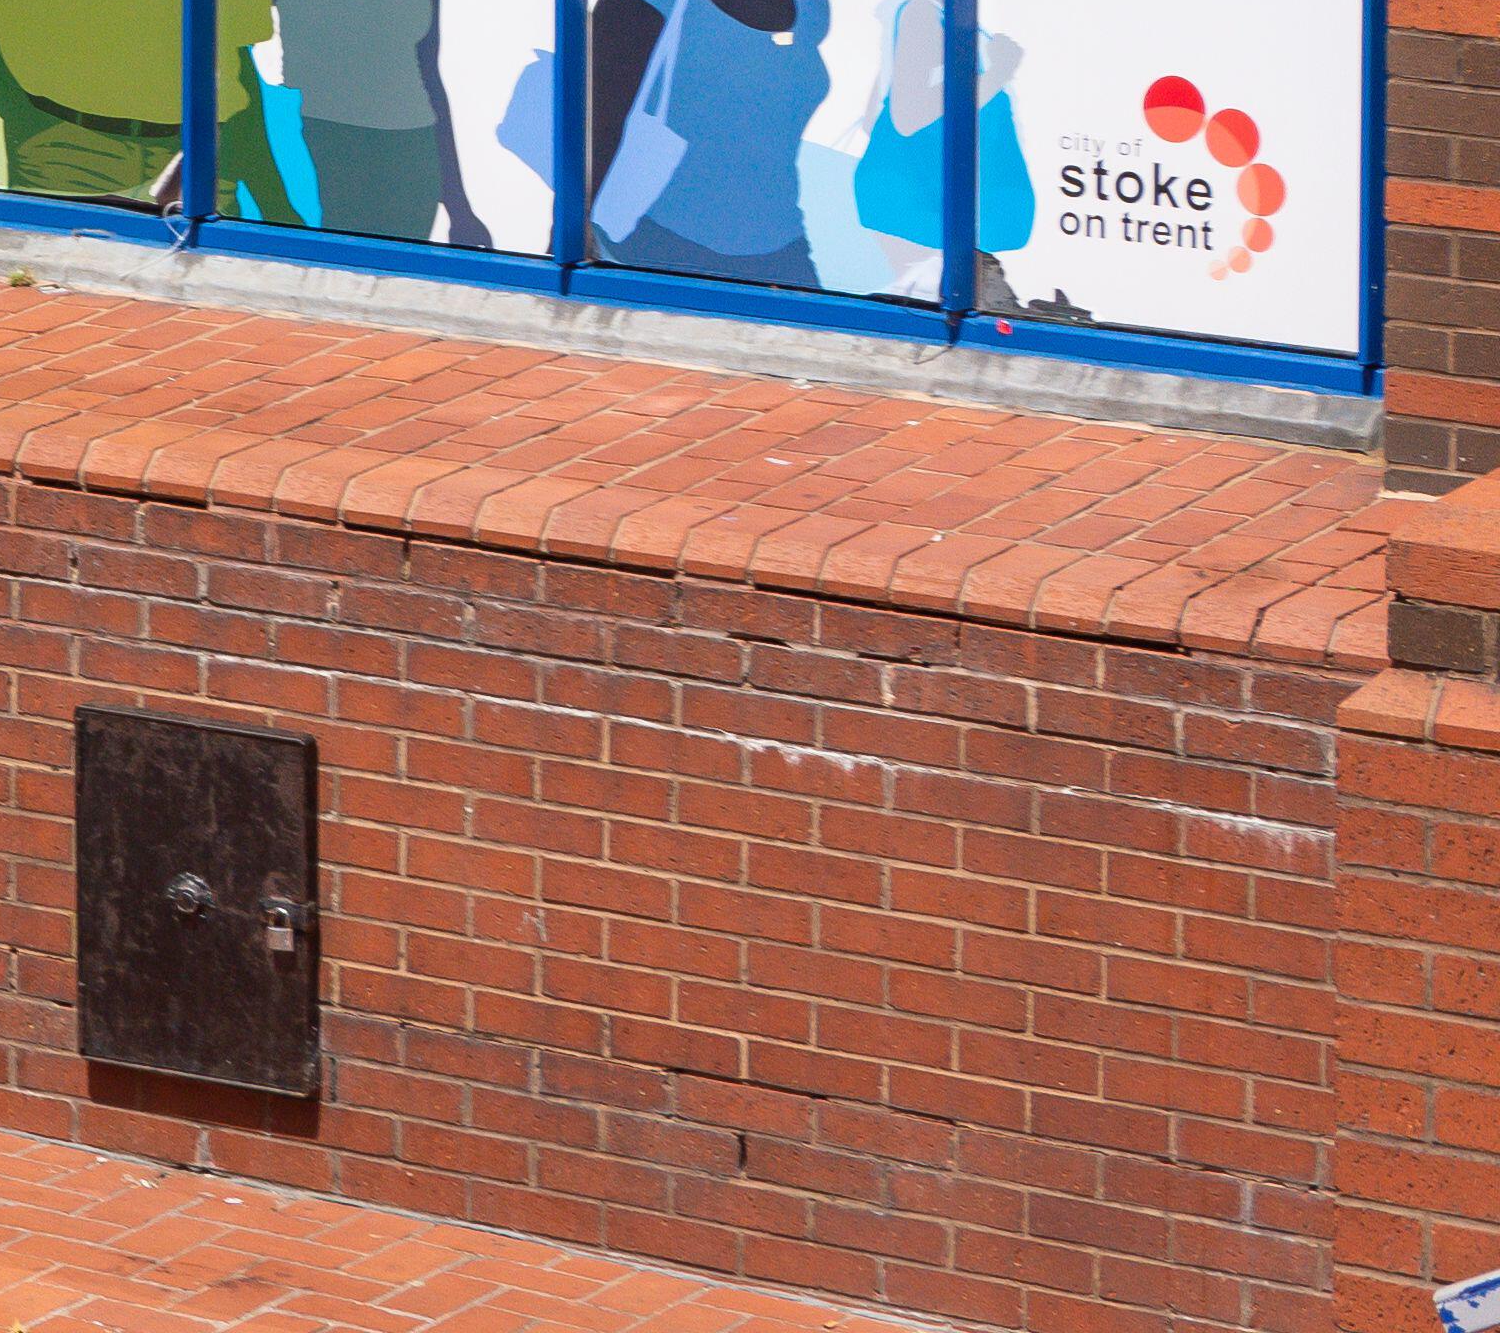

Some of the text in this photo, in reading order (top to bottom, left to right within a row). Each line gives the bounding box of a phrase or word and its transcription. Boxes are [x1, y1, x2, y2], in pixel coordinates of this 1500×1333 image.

[1059, 132, 1143, 157] city of
[1060, 159, 1213, 212] stoke
[1059, 211, 1213, 251] on trent
